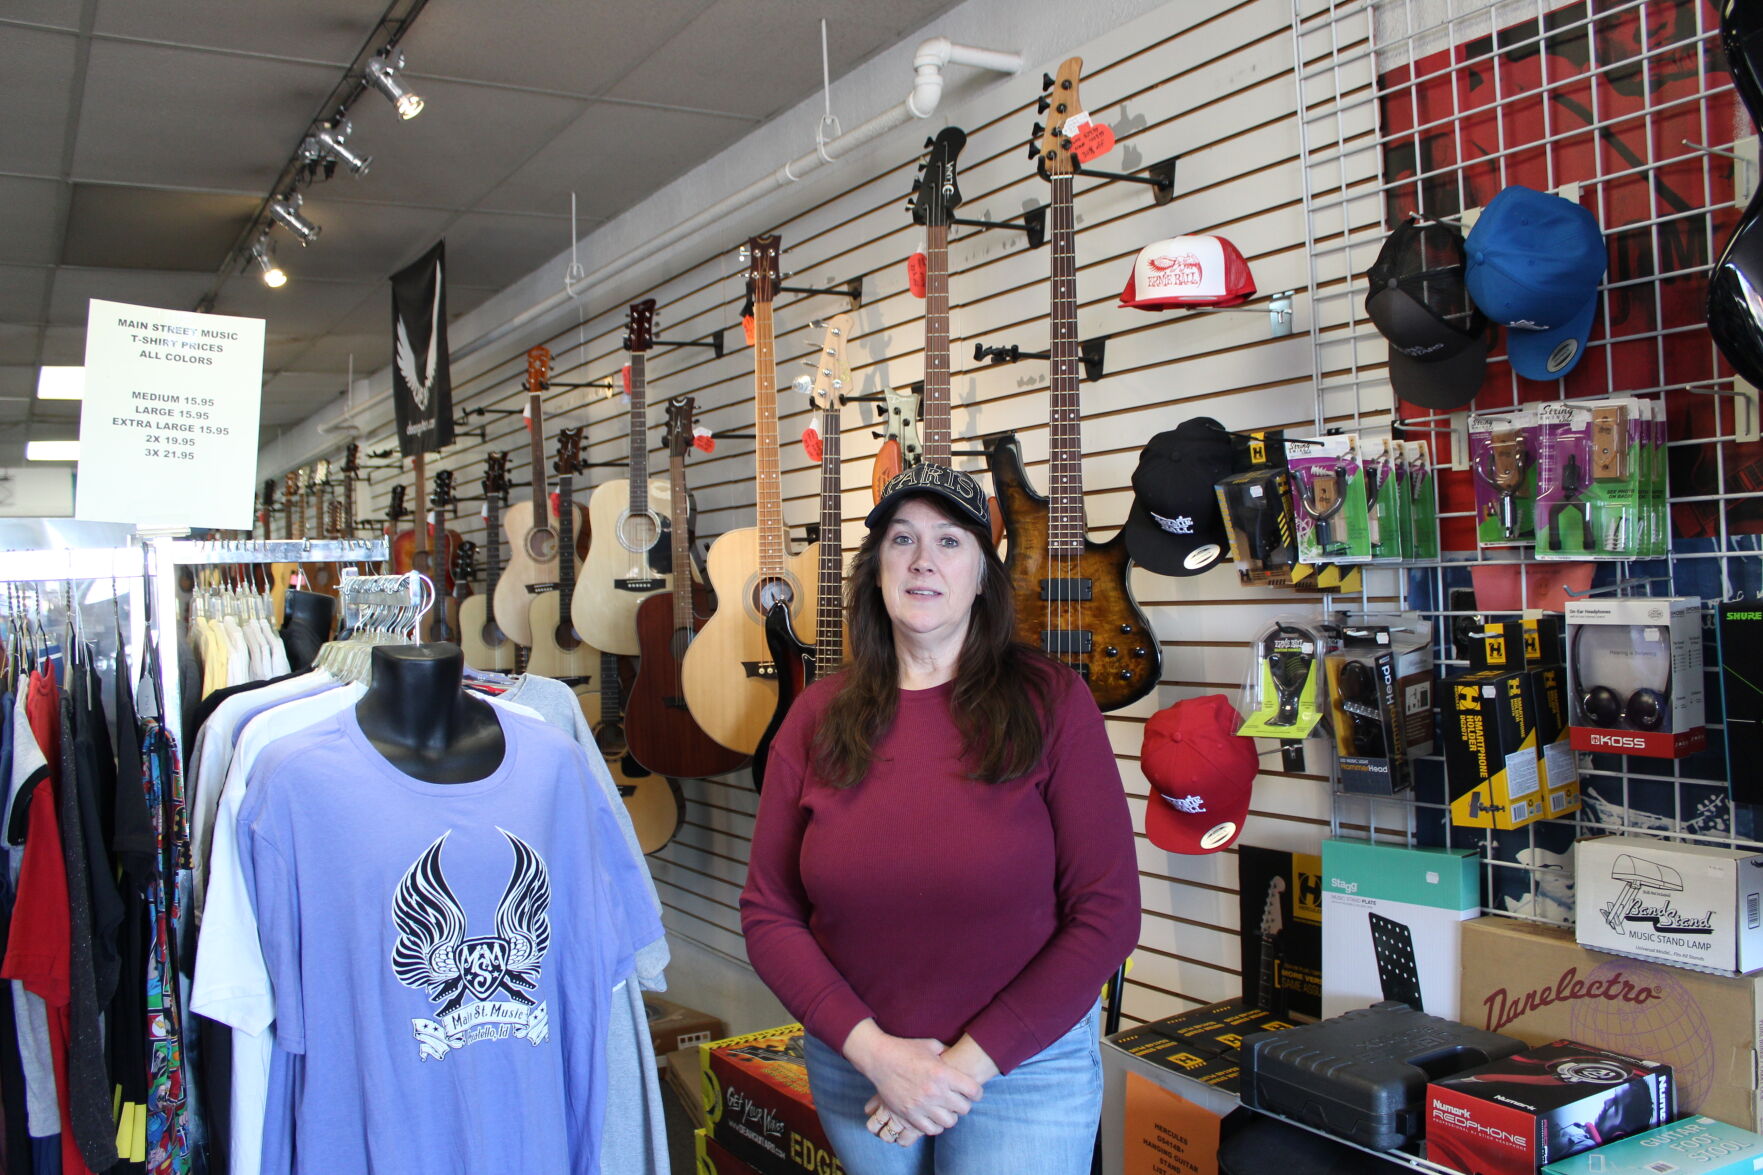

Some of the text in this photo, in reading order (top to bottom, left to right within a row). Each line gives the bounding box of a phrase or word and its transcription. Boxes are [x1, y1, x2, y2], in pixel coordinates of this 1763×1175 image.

[118, 318, 239, 341] MAIN STREET MUSIC
[131, 334, 224, 353] T-SHIRT PRICES
[139, 350, 213, 365] ALL COLORS
[132, 391, 215, 407] MEDIUM 15.95
[135, 405, 210, 420] LARGE 15.95
[1539, 404, 1574, 418] String
[112, 417, 230, 436] EXTRA LARGE 15.95
[146, 434, 196, 447] 2X 19.95
[145, 448, 195, 460] 3X 21.95
[882, 461, 974, 499] PARIS
[1726, 611, 1763, 621] SHURE
[1466, 715, 1477, 752] HOLDER
[1600, 735, 1646, 750] KOSS
[1473, 715, 1489, 779] SMARTPHONE
[1331, 877, 1358, 894] Stagg
[1628, 930, 1712, 951] MUSIC STAND LAMP
[1483, 966, 1661, 1033] Danelectro
[474, 1004, 488, 1019] St.
[490, 1003, 524, 1020] Music
[1433, 1098, 1471, 1119] Numark
[1494, 1095, 1537, 1111] Numark
[1154, 1122, 1189, 1146] HERCULES
[1433, 1109, 1527, 1147] REDPHONE
[1640, 1124, 1706, 1148] GUITAR
[1669, 1132, 1722, 1152] FOOT
[1688, 1140, 1755, 1163] STOOL
[1143, 1138, 1200, 1173] HANGING GUITAR
[1160, 1157, 1181, 1174] STAND
